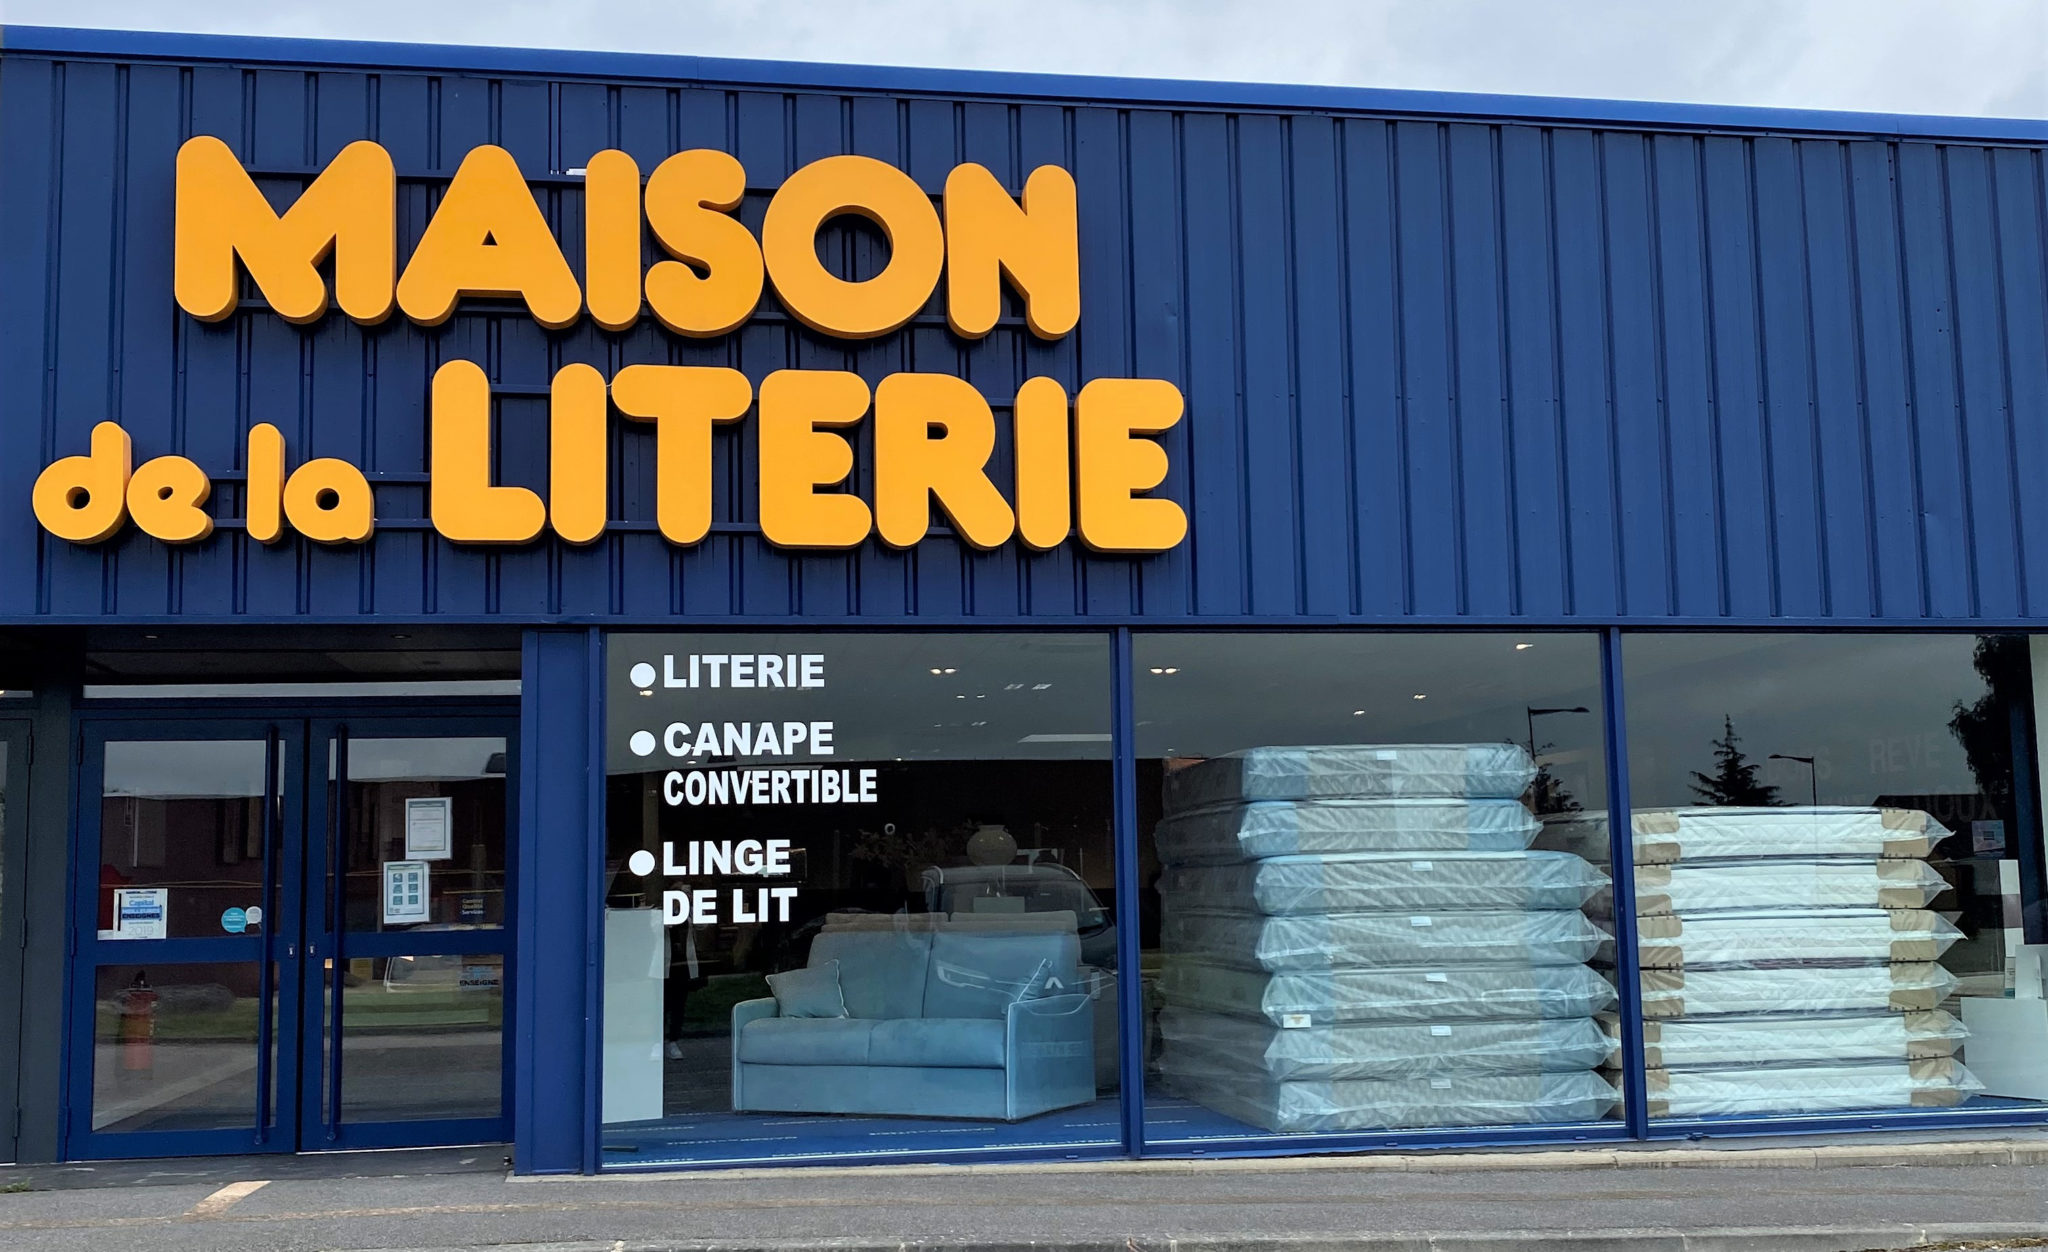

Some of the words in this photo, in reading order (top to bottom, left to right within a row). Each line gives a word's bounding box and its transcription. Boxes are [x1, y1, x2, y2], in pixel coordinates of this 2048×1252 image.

[174, 135, 1080, 340] MAISON
[32, 421, 213, 541] de
[247, 422, 374, 542] la
[430, 359, 1188, 551] LITERIE
[663, 654, 825, 689] LITERIE
[663, 721, 834, 757] CANAPE
[663, 768, 878, 806] CONVERTIBLE
[663, 839, 792, 876] LINGE
[663, 889, 719, 926] DE
[732, 887, 798, 924] LIT
